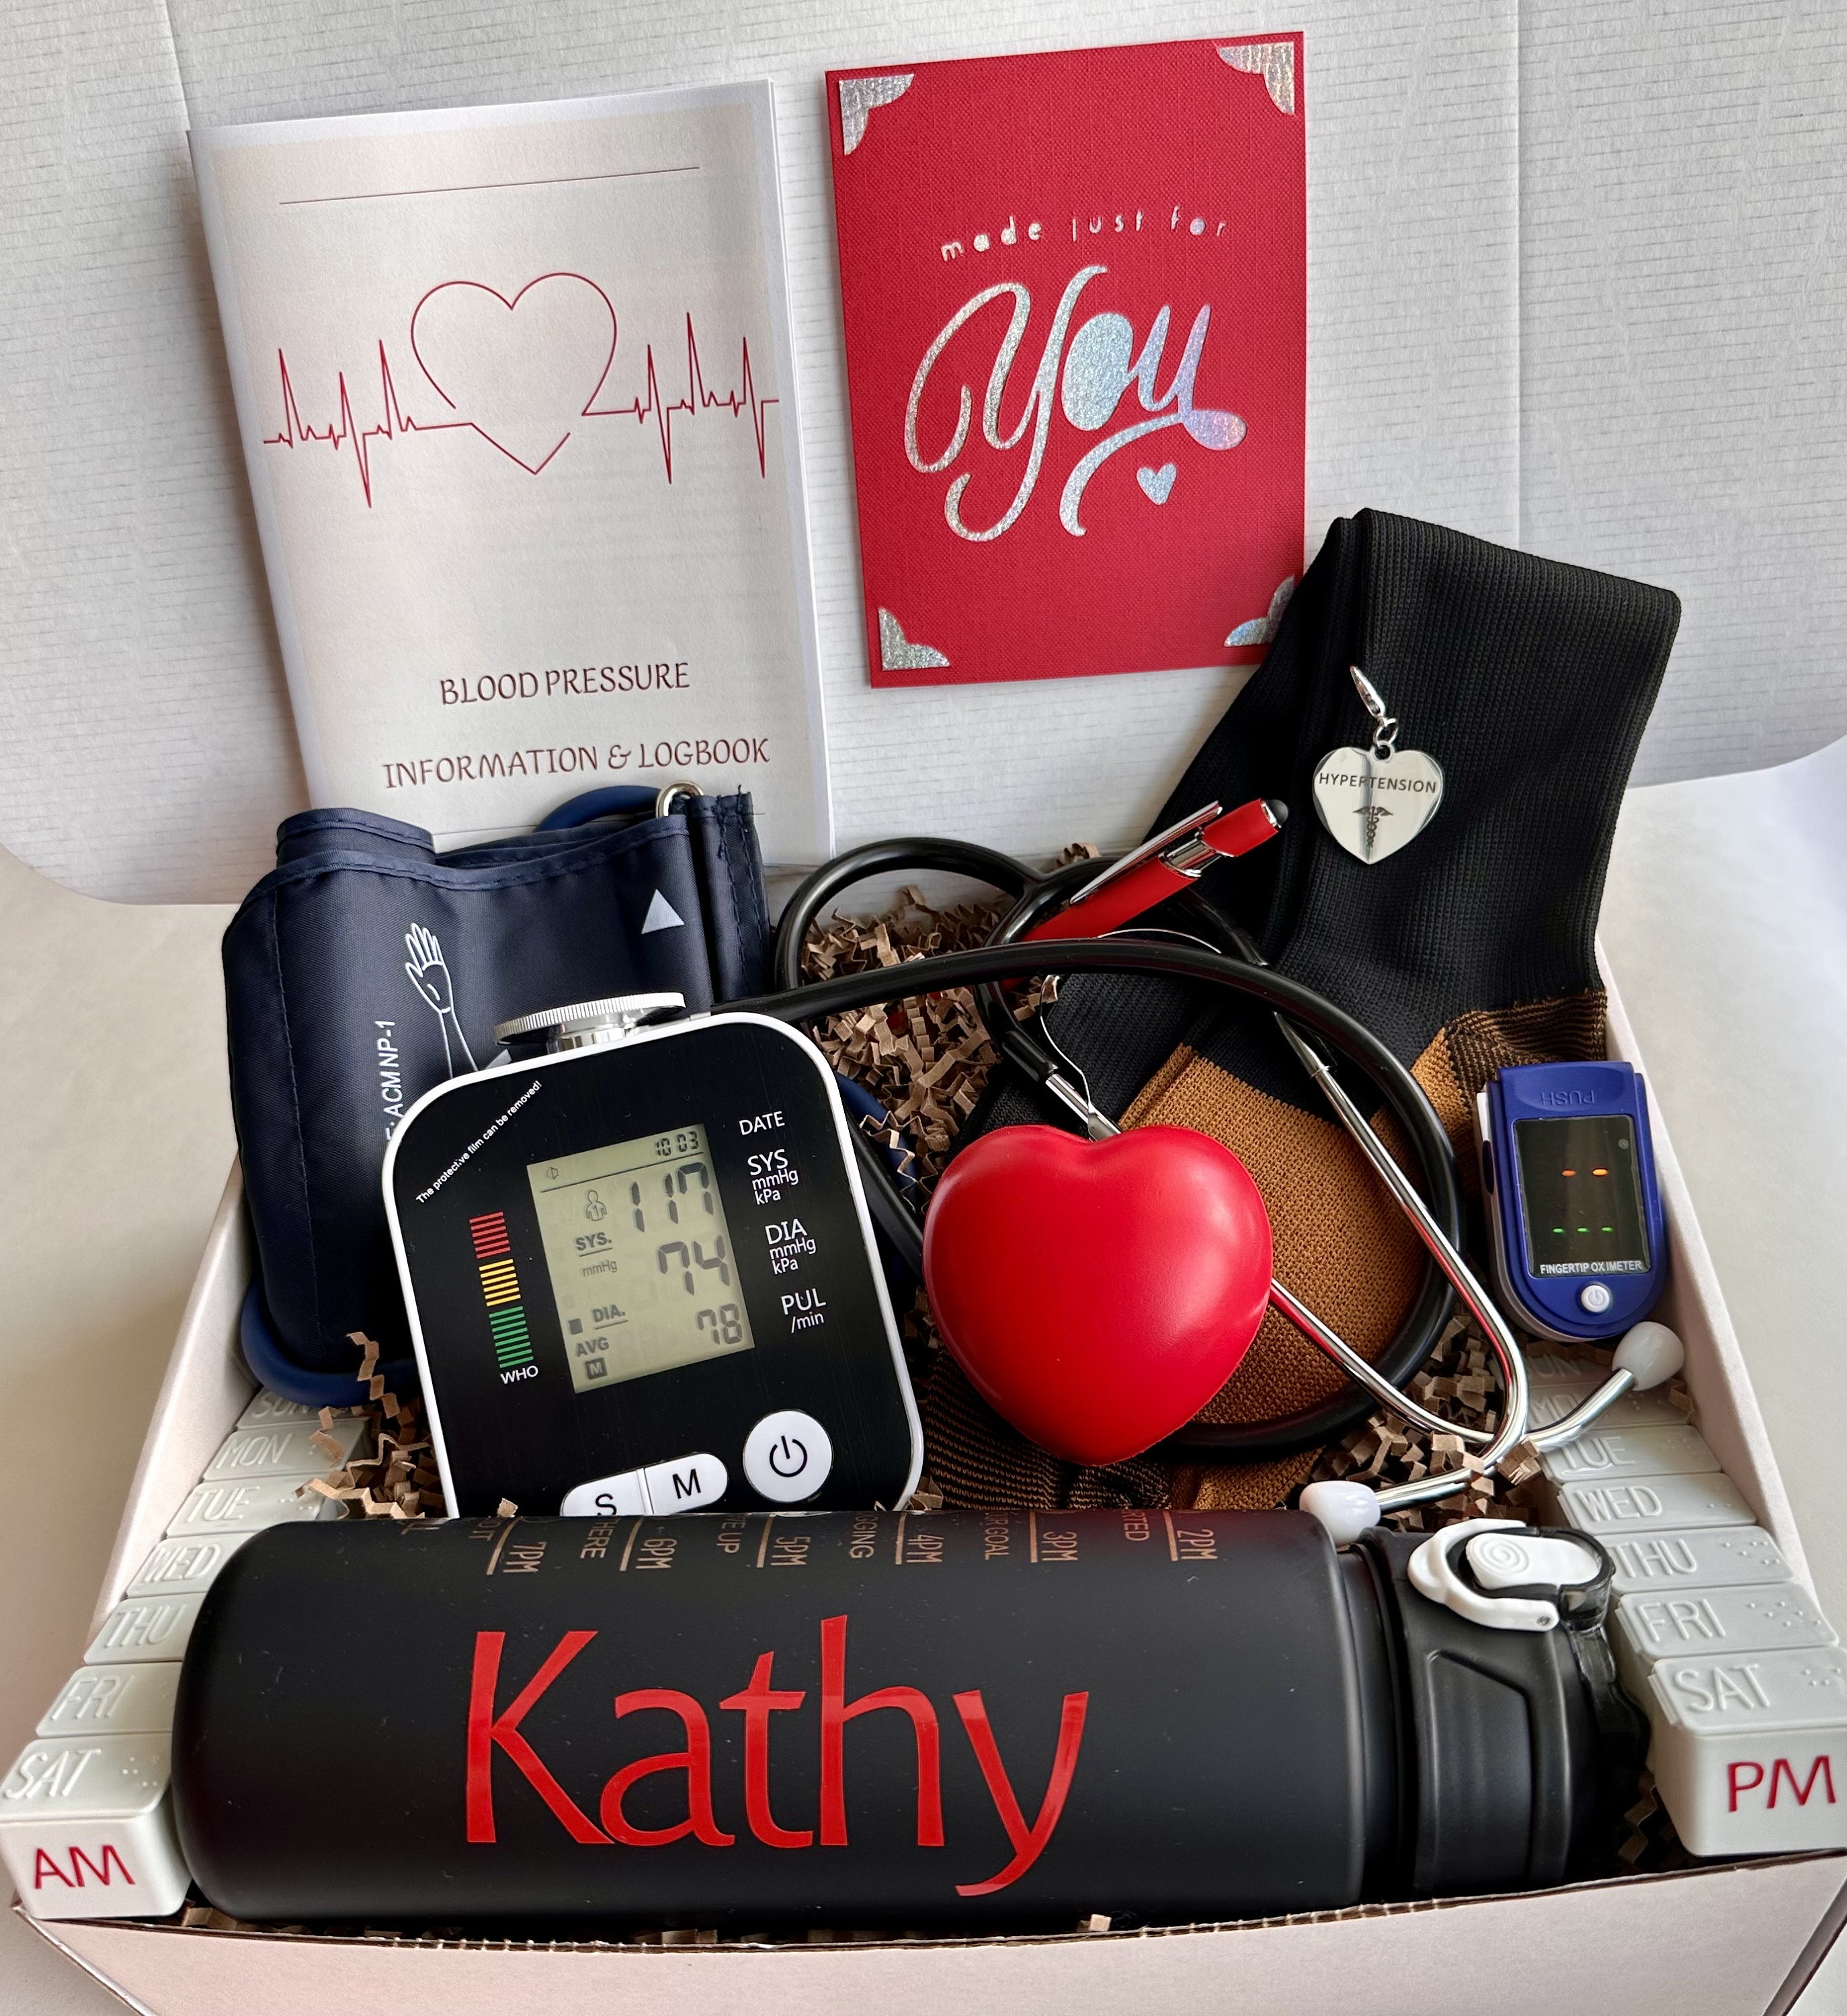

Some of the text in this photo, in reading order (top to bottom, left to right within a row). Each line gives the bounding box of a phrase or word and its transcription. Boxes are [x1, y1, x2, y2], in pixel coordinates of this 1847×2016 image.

[941, 204, 1227, 262] made just for
[905, 265, 1247, 542] You
[440, 661, 691, 706] BLOOD PRESSURE
[383, 738, 772, 789] INFORMATION & LOGBOOK
[1319, 772, 1436, 794] HYPERTENSION
[1540, 1089, 1596, 1107] PUSH
[739, 1110, 786, 1136] DATE
[415, 1080, 542, 1204] The protective film can be removed!
[747, 1148, 788, 1175] SYS
[751, 1169, 799, 1191] mmHg
[630, 1161, 714, 1233] 117
[754, 1189, 781, 1206] kPa
[575, 1232, 613, 1252] SYS.
[765, 1218, 808, 1245] DIA
[657, 1234, 731, 1296] 74
[769, 1238, 816, 1260] mmHg
[581, 1259, 618, 1277] mmHg
[772, 1257, 799, 1275] kPa
[1540, 1262, 1590, 1275] FINGERTIP
[592, 1304, 626, 1323] DIA.
[780, 1288, 827, 1315] PUL
[696, 1302, 743, 1345] 78
[790, 1311, 825, 1334] /min
[576, 1337, 610, 1357] AVG
[499, 1365, 539, 1385] WHO
[1529, 1391, 1582, 1425] MO
[216, 1433, 293, 1469] MON
[673, 1468, 701, 1499] M
[186, 1486, 261, 1523] TUE
[595, 1493, 617, 1515] S
[1575, 1485, 1663, 1522] WED
[849, 1514, 878, 1559] GGING
[1121, 1511, 1150, 1542] RTED
[502, 1541, 547, 1572] 7PM
[635, 1538, 678, 1570] 6PM
[716, 1532, 741, 1554] UP
[770, 1536, 811, 1566] 5PM
[906, 1534, 944, 1563] 4PM
[983, 1527, 1010, 1560] GOAL
[1041, 1531, 1079, 1562] 3PM
[1176, 1528, 1219, 1560] 2PM
[1606, 1539, 1697, 1578] THU
[142, 1543, 222, 1583] WED
[106, 1604, 186, 1648] THU
[1637, 1598, 1726, 1642] FRI
[50, 1675, 136, 1721] FRI
[1674, 1663, 1770, 1712] SAT
[466, 1614, 1090, 1896] Kathy
[4, 1747, 103, 1799] SAT
[1727, 1755, 1836, 1813] PM
[34, 1844, 136, 1890] AM
